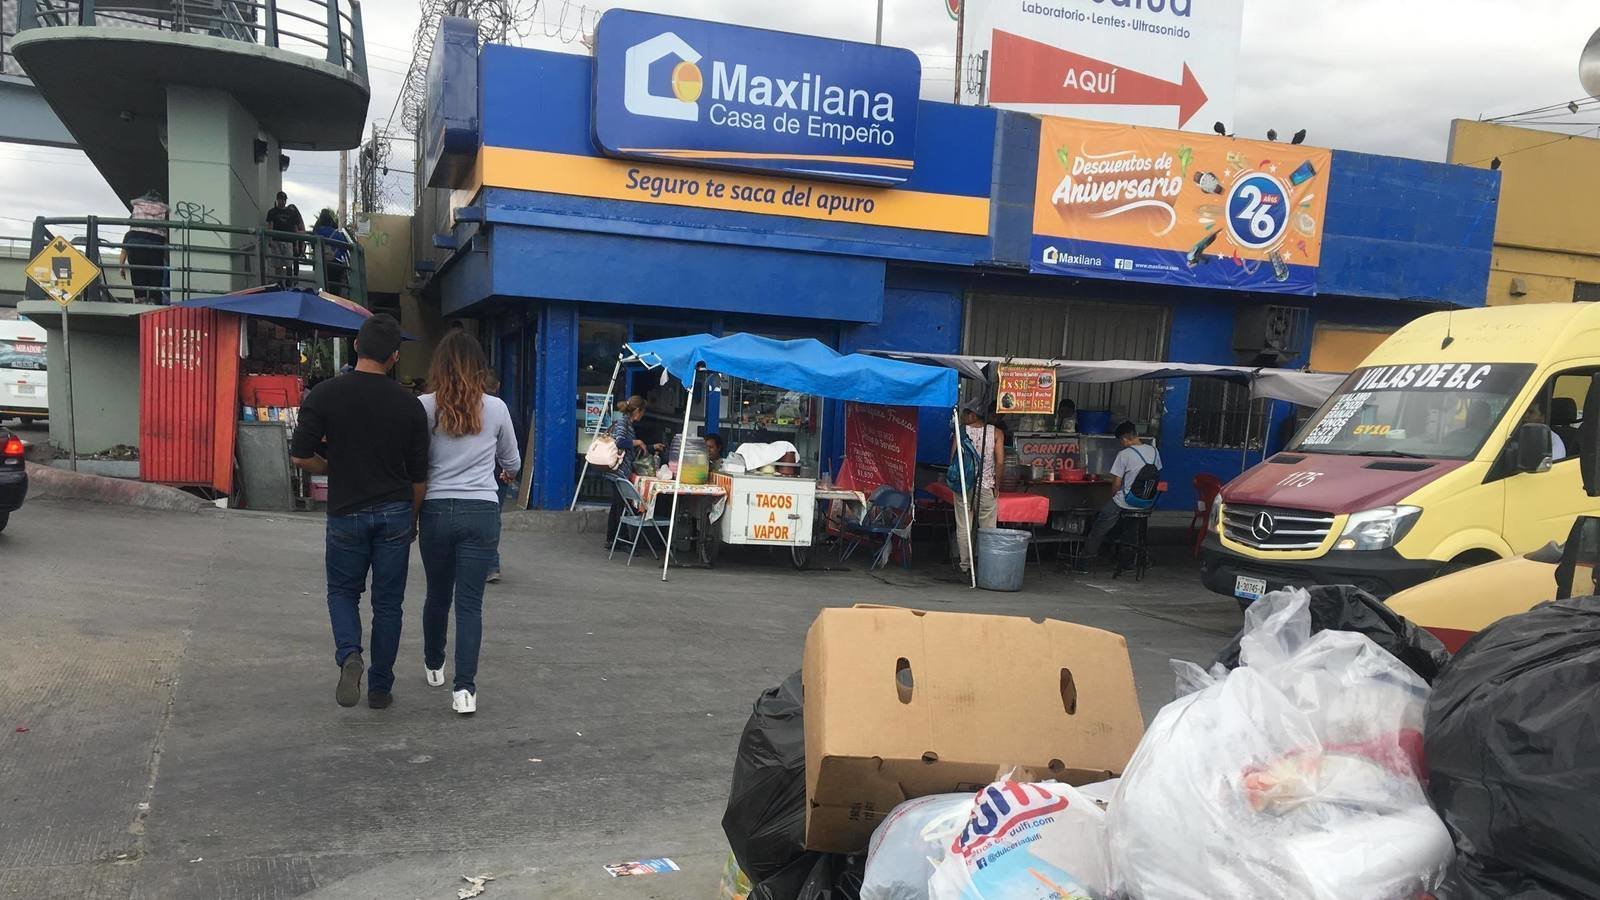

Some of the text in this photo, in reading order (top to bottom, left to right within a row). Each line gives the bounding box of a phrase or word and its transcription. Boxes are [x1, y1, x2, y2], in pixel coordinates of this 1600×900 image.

[1022, 1, 1085, 22] Laboratorio
[1092, 12, 1126, 28] Lentes
[1132, 19, 1190, 39] Ultrasonido
[711, 61, 894, 122] Maxilana
[1063, 68, 1118, 94] AQUÍ
[709, 103, 894, 146] Casa de Empeño
[1072, 152, 1173, 176] Descuentos de
[625, 168, 875, 215] Seguro te saca del apuro
[1052, 171, 1183, 206] Aniversario
[1235, 184, 1275, 238] 26
[1059, 252, 1102, 267] Maxilana
[1353, 364, 1492, 391] VILLAS DE B.C
[755, 494, 792, 509] TACOS
[768, 511, 776, 523] A
[753, 524, 789, 539] VAPOR
[1009, 815, 1055, 837] dulfi.com
[988, 833, 1042, 863] @dulceriadulfi
